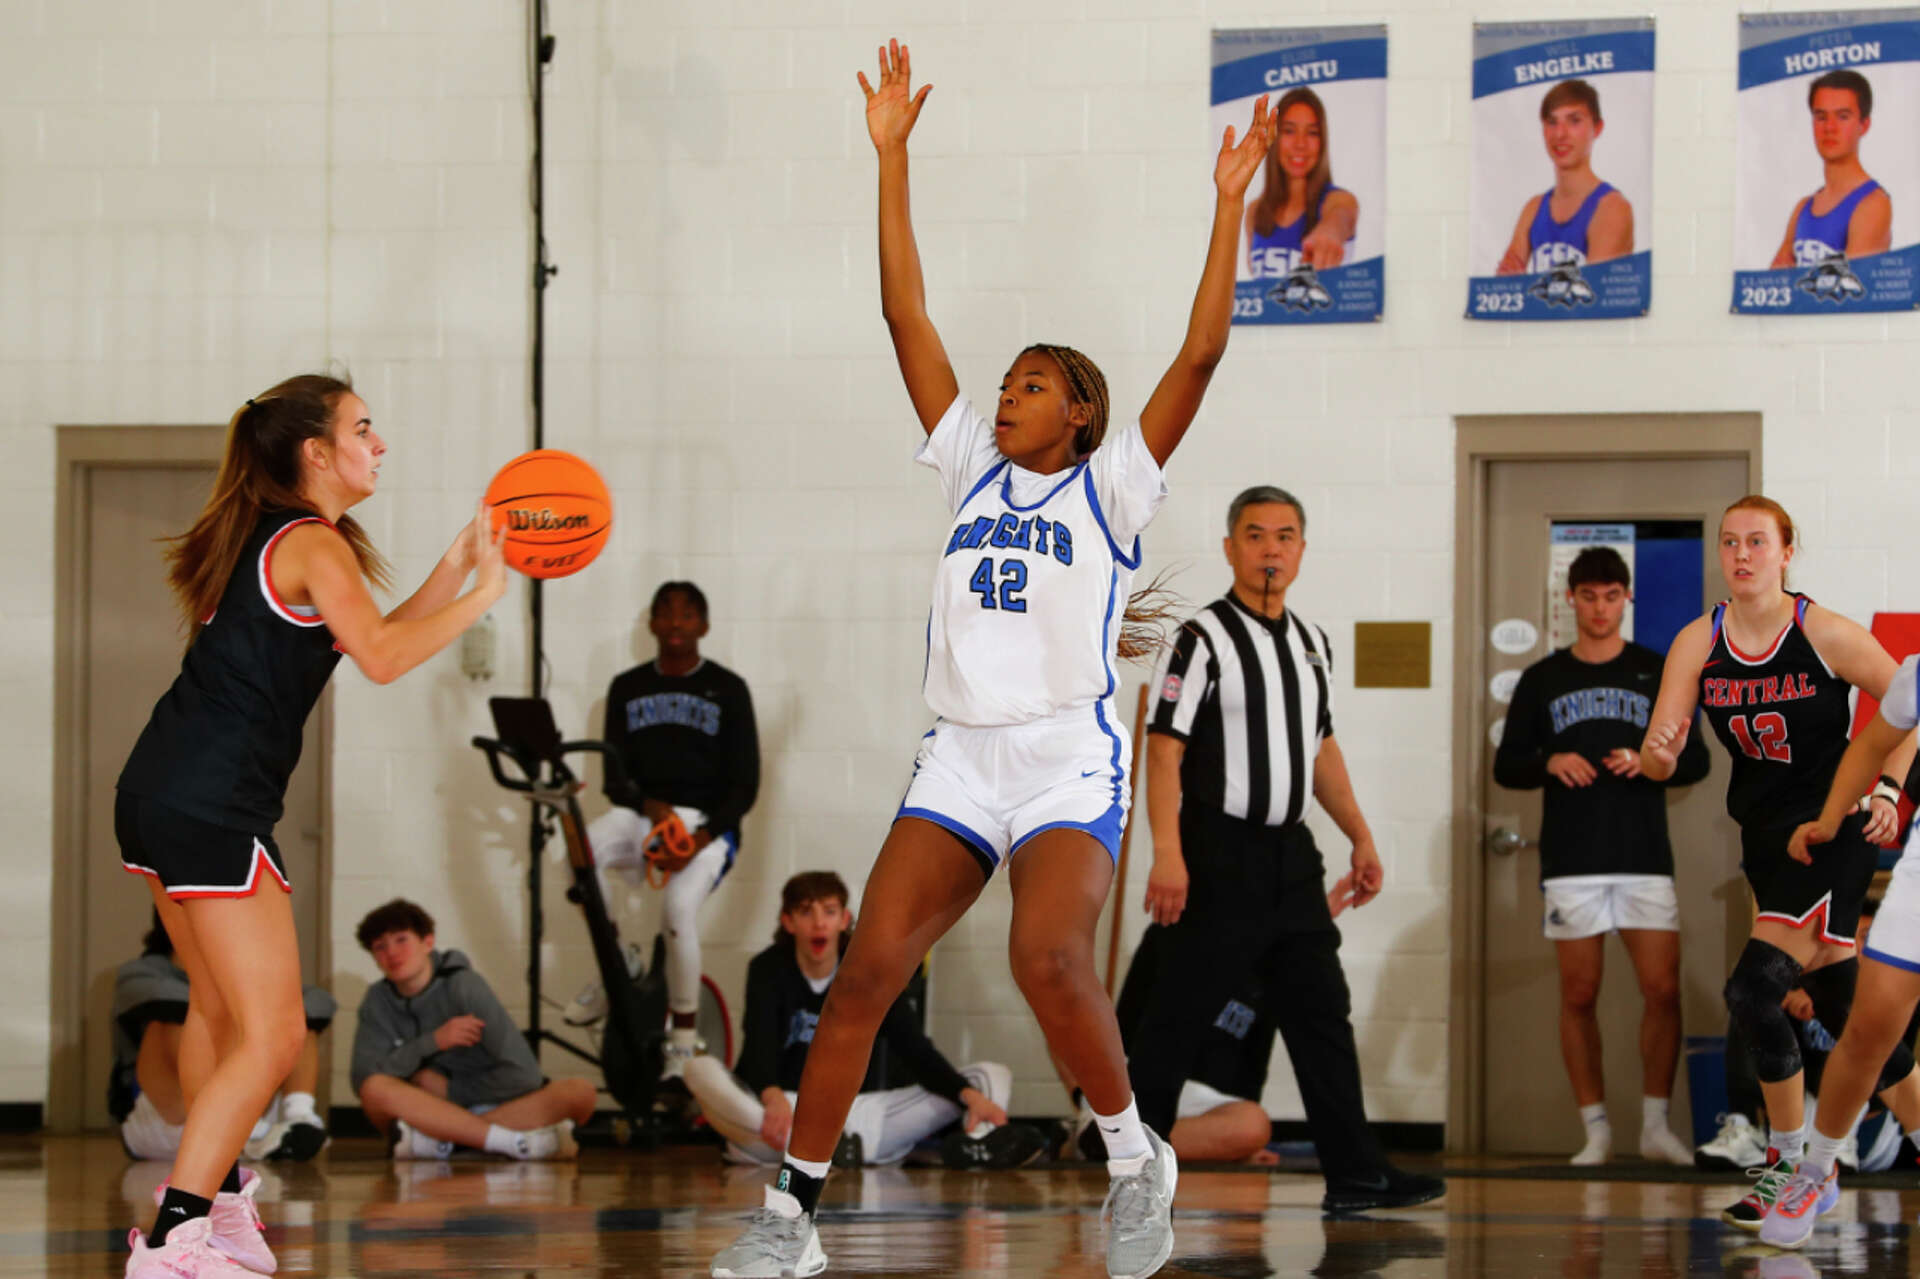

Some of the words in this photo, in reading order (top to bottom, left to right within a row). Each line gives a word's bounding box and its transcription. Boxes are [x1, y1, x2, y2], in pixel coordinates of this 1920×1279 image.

[1264, 59, 1339, 87] CANTU
[1514, 51, 1614, 83] ENGELKE
[1784, 41, 1881, 74] HORTON
[1476, 292, 1524, 313] 2023
[1742, 287, 1792, 307] 2023
[506, 508, 590, 531] Wilson
[969, 557, 1028, 613] 42
[1703, 673, 1816, 707] CENTRAL
[1550, 686, 1650, 734] KNIGHTS
[1728, 711, 1792, 764] 12
